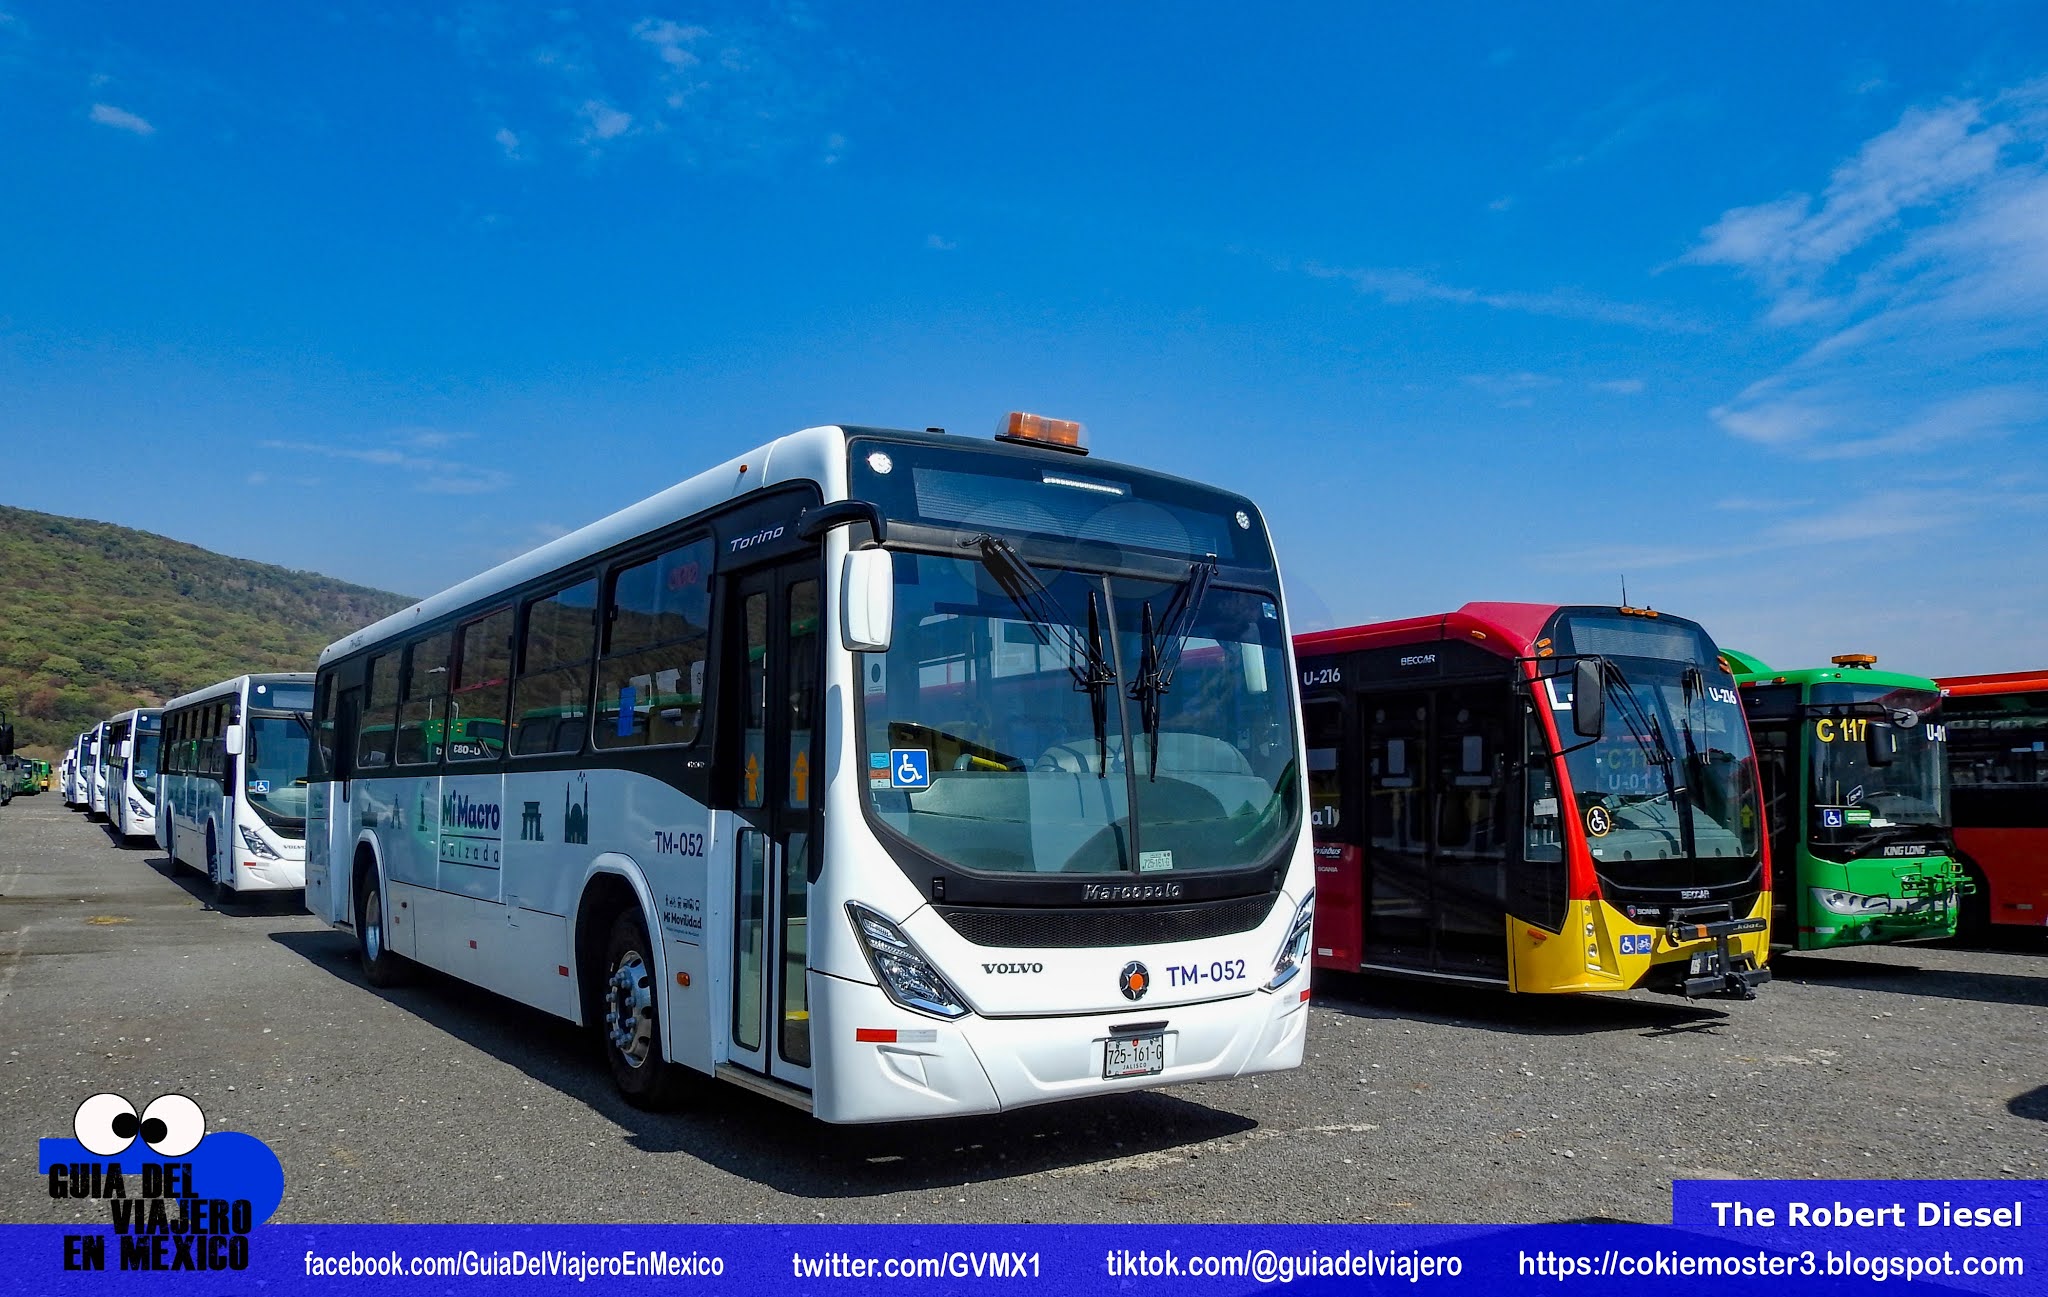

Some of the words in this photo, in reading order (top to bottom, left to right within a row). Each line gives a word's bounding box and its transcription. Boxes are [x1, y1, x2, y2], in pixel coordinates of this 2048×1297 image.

[730, 526, 784, 552] Torino
[1400, 654, 1436, 666] BECCAR
[1303, 667, 1341, 686] U-216
[1708, 686, 1738, 705] U-216
[1816, 718, 1835, 743] C
[1840, 718, 1867, 742] 117
[442, 789, 457, 828] Mi
[458, 794, 500, 831] Macro
[441, 840, 499, 863] Calzada
[655, 831, 703, 857] TM-052
[1884, 846, 1904, 856] KING
[1905, 845, 1926, 855] LONG
[1083, 882, 1180, 900] Marcopolo
[1681, 890, 1710, 900] BECCAR
[981, 963, 1043, 975] VOLVO
[1166, 959, 1246, 987] TM-052
[1108, 1044, 1162, 1065] 725-161-G
[1122, 1062, 1147, 1070] JALISCO
